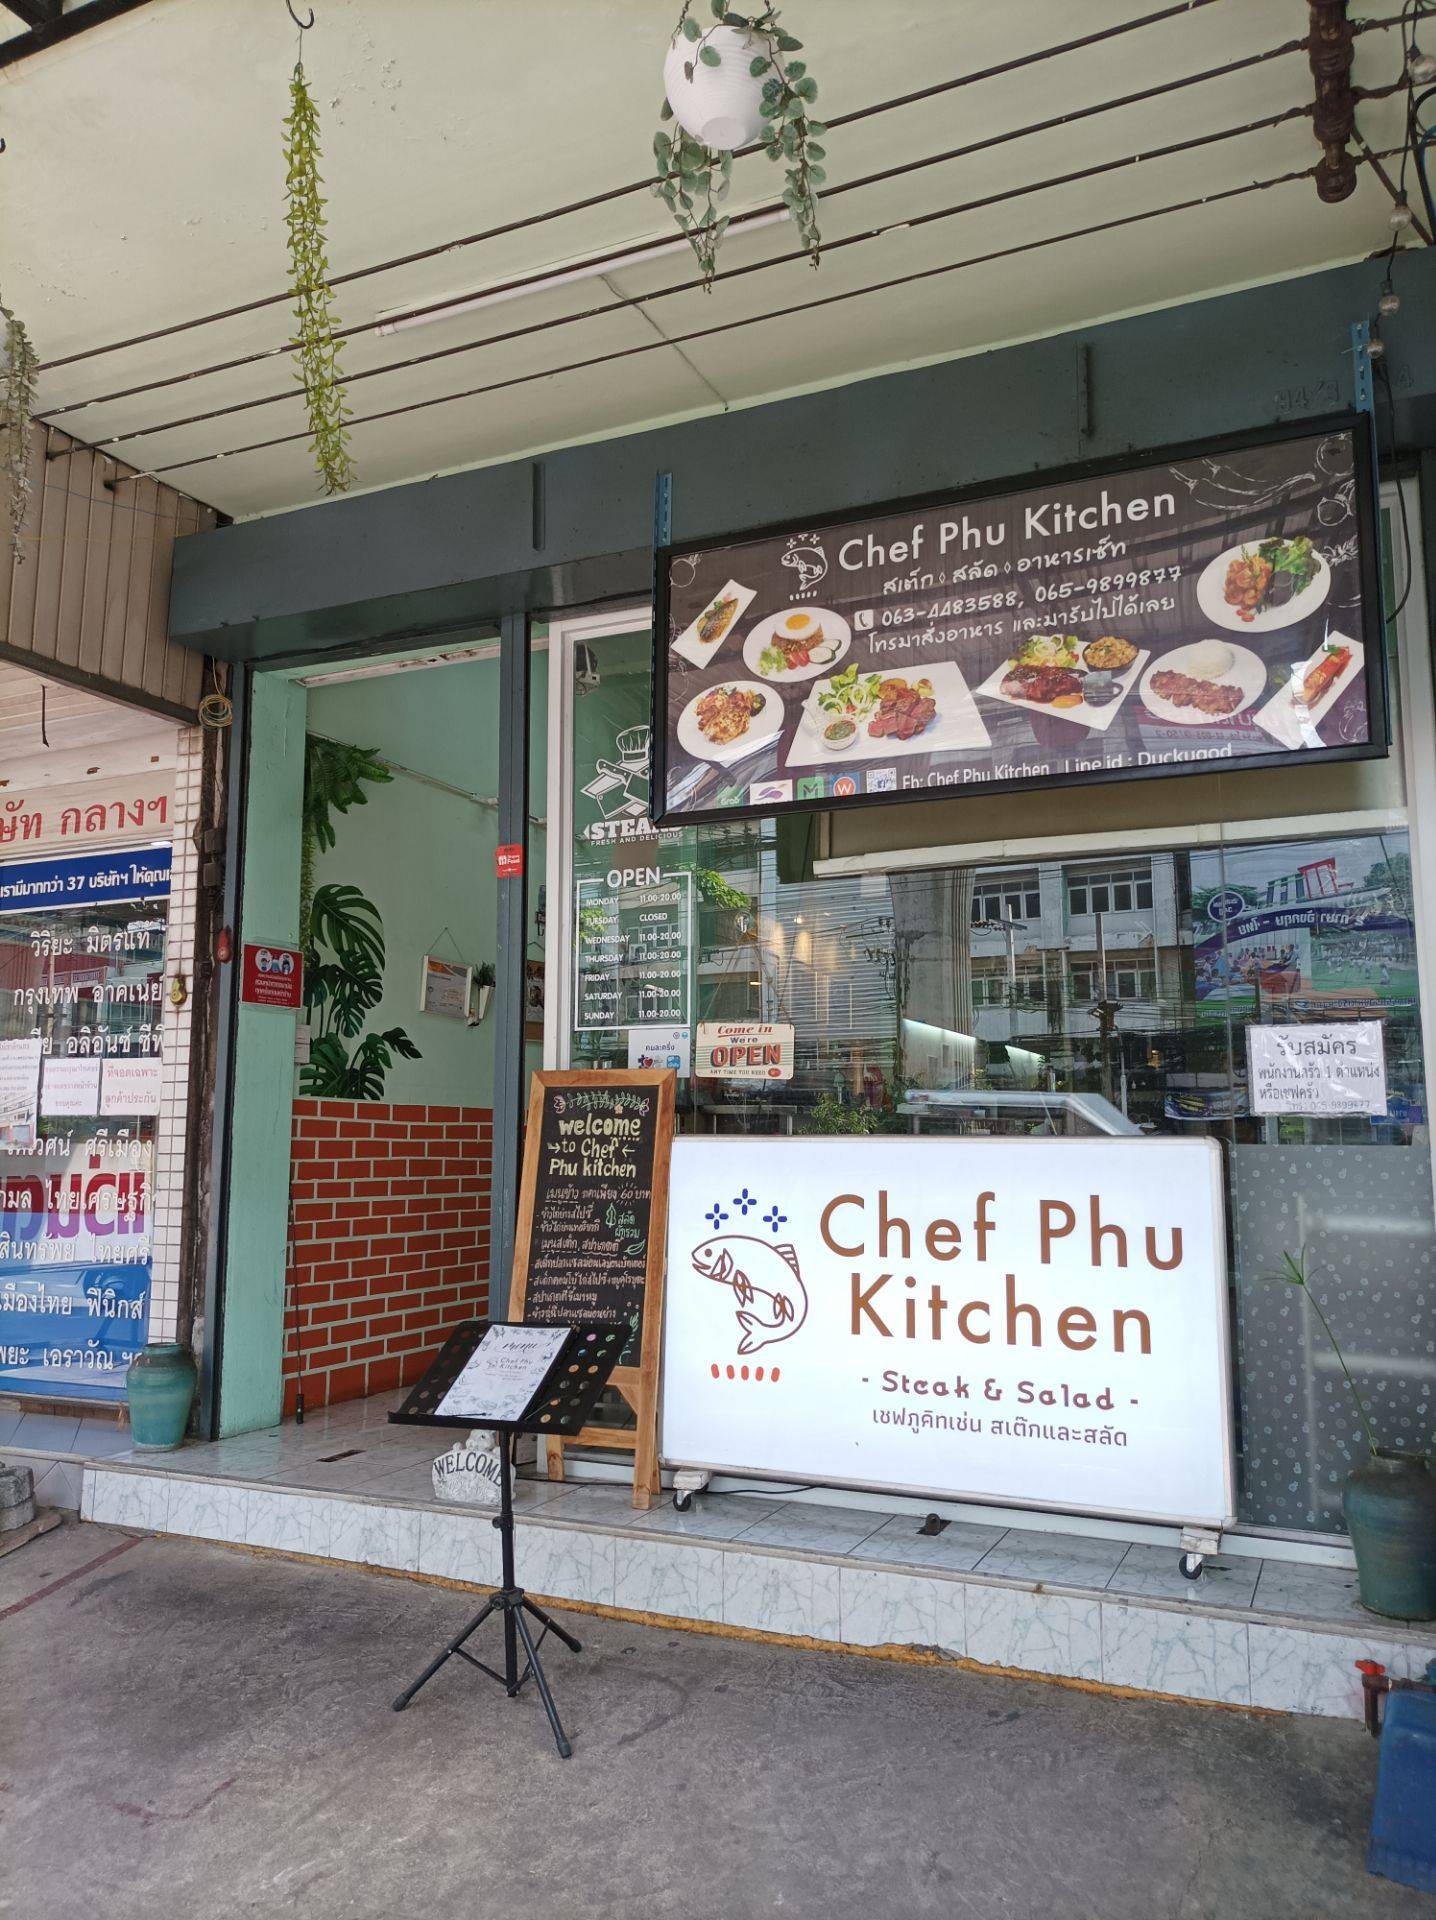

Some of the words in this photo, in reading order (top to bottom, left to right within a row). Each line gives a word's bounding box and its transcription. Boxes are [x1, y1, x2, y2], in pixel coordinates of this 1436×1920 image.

[838, 524, 924, 571] Chef
[940, 516, 1005, 555] Phu
[1025, 491, 1176, 539] Kitchen
[883, 569, 934, 595] สเต็ก
[952, 563, 999, 585] สลัด
[881, 591, 1025, 628] 063-4483588,
[1035, 565, 1182, 603] 065-9899877
[868, 621, 1003, 654] โทรมาสั่งอาหาร
[1013, 596, 1175, 633] และมารับไปได้เลย
[927, 769, 959, 786] Chef
[995, 762, 1049, 780] Kitchen
[61, 796, 168, 836] กลางฯ
[591, 817, 682, 840] STEA
[620, 836, 637, 844] AND
[640, 830, 683, 841] DELICIOUS
[66, 876, 86, 891] 37
[607, 867, 660, 888] OPEN
[586, 897, 619, 906] MONDAY
[640, 912, 667, 922] CLOSED
[585, 935, 630, 944] WEDNESDAY
[640, 932, 681, 941] 11.00-20.00
[585, 954, 623, 963] THURSDAY
[639, 951, 681, 960] 11.00-20.00
[584, 973, 610, 982] FRIDAY
[639, 970, 681, 979] 11.00-20.00
[14, 986, 79, 1014] กรุงเทพ
[584, 992, 622, 1001] SATURDAY
[639, 989, 681, 998] 11.00-20.00
[584, 1012, 614, 1020] SUNDAY
[638, 1009, 681, 1018] 11.00-20.00
[718, 1025, 754, 1034] Come
[758, 1025, 773, 1033] in
[711, 1043, 781, 1068] OPEN
[558, 1113, 641, 1136] welcome
[561, 1138, 576, 1153] to
[580, 1137, 619, 1158] Chef
[549, 1158, 578, 1175] Phu
[582, 1157, 637, 1178] kitchen
[620, 1189, 633, 1199] 60
[820, 1190, 996, 1263] Chef
[1038, 1194, 1184, 1271] Phu
[850, 1273, 1153, 1355] Kitchen
[43, 1338, 114, 1370] เอราวัณ
[881, 1370, 970, 1399] Steak
[984, 1378, 1003, 1401] &
[1016, 1381, 1115, 1411] Salad
[872, 1407, 982, 1434] เชฟภูคิทเช่น
